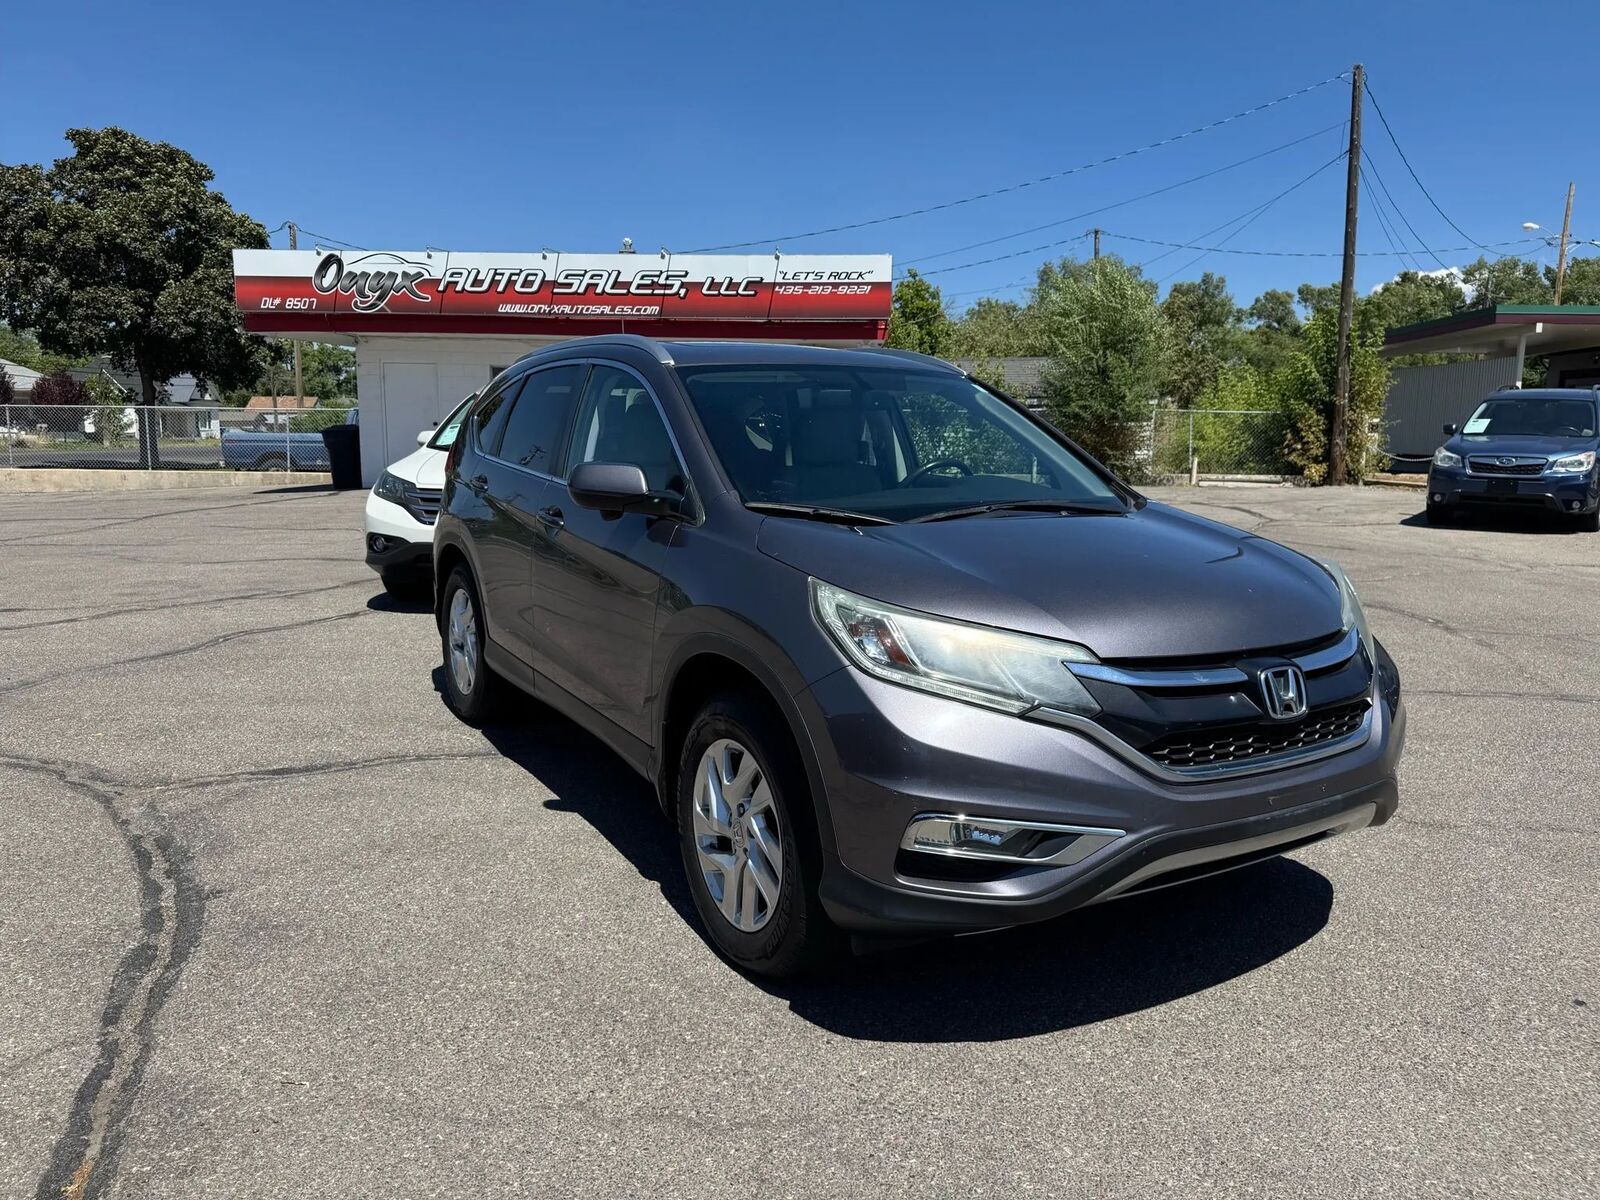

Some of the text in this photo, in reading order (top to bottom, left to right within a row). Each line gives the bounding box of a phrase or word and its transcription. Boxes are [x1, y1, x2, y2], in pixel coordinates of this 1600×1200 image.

[313, 252, 763, 313] Onyx AUTO SALES, LLC
[774, 285, 871, 295] 435-213-9221
[260, 297, 317, 310] DL# 8507
